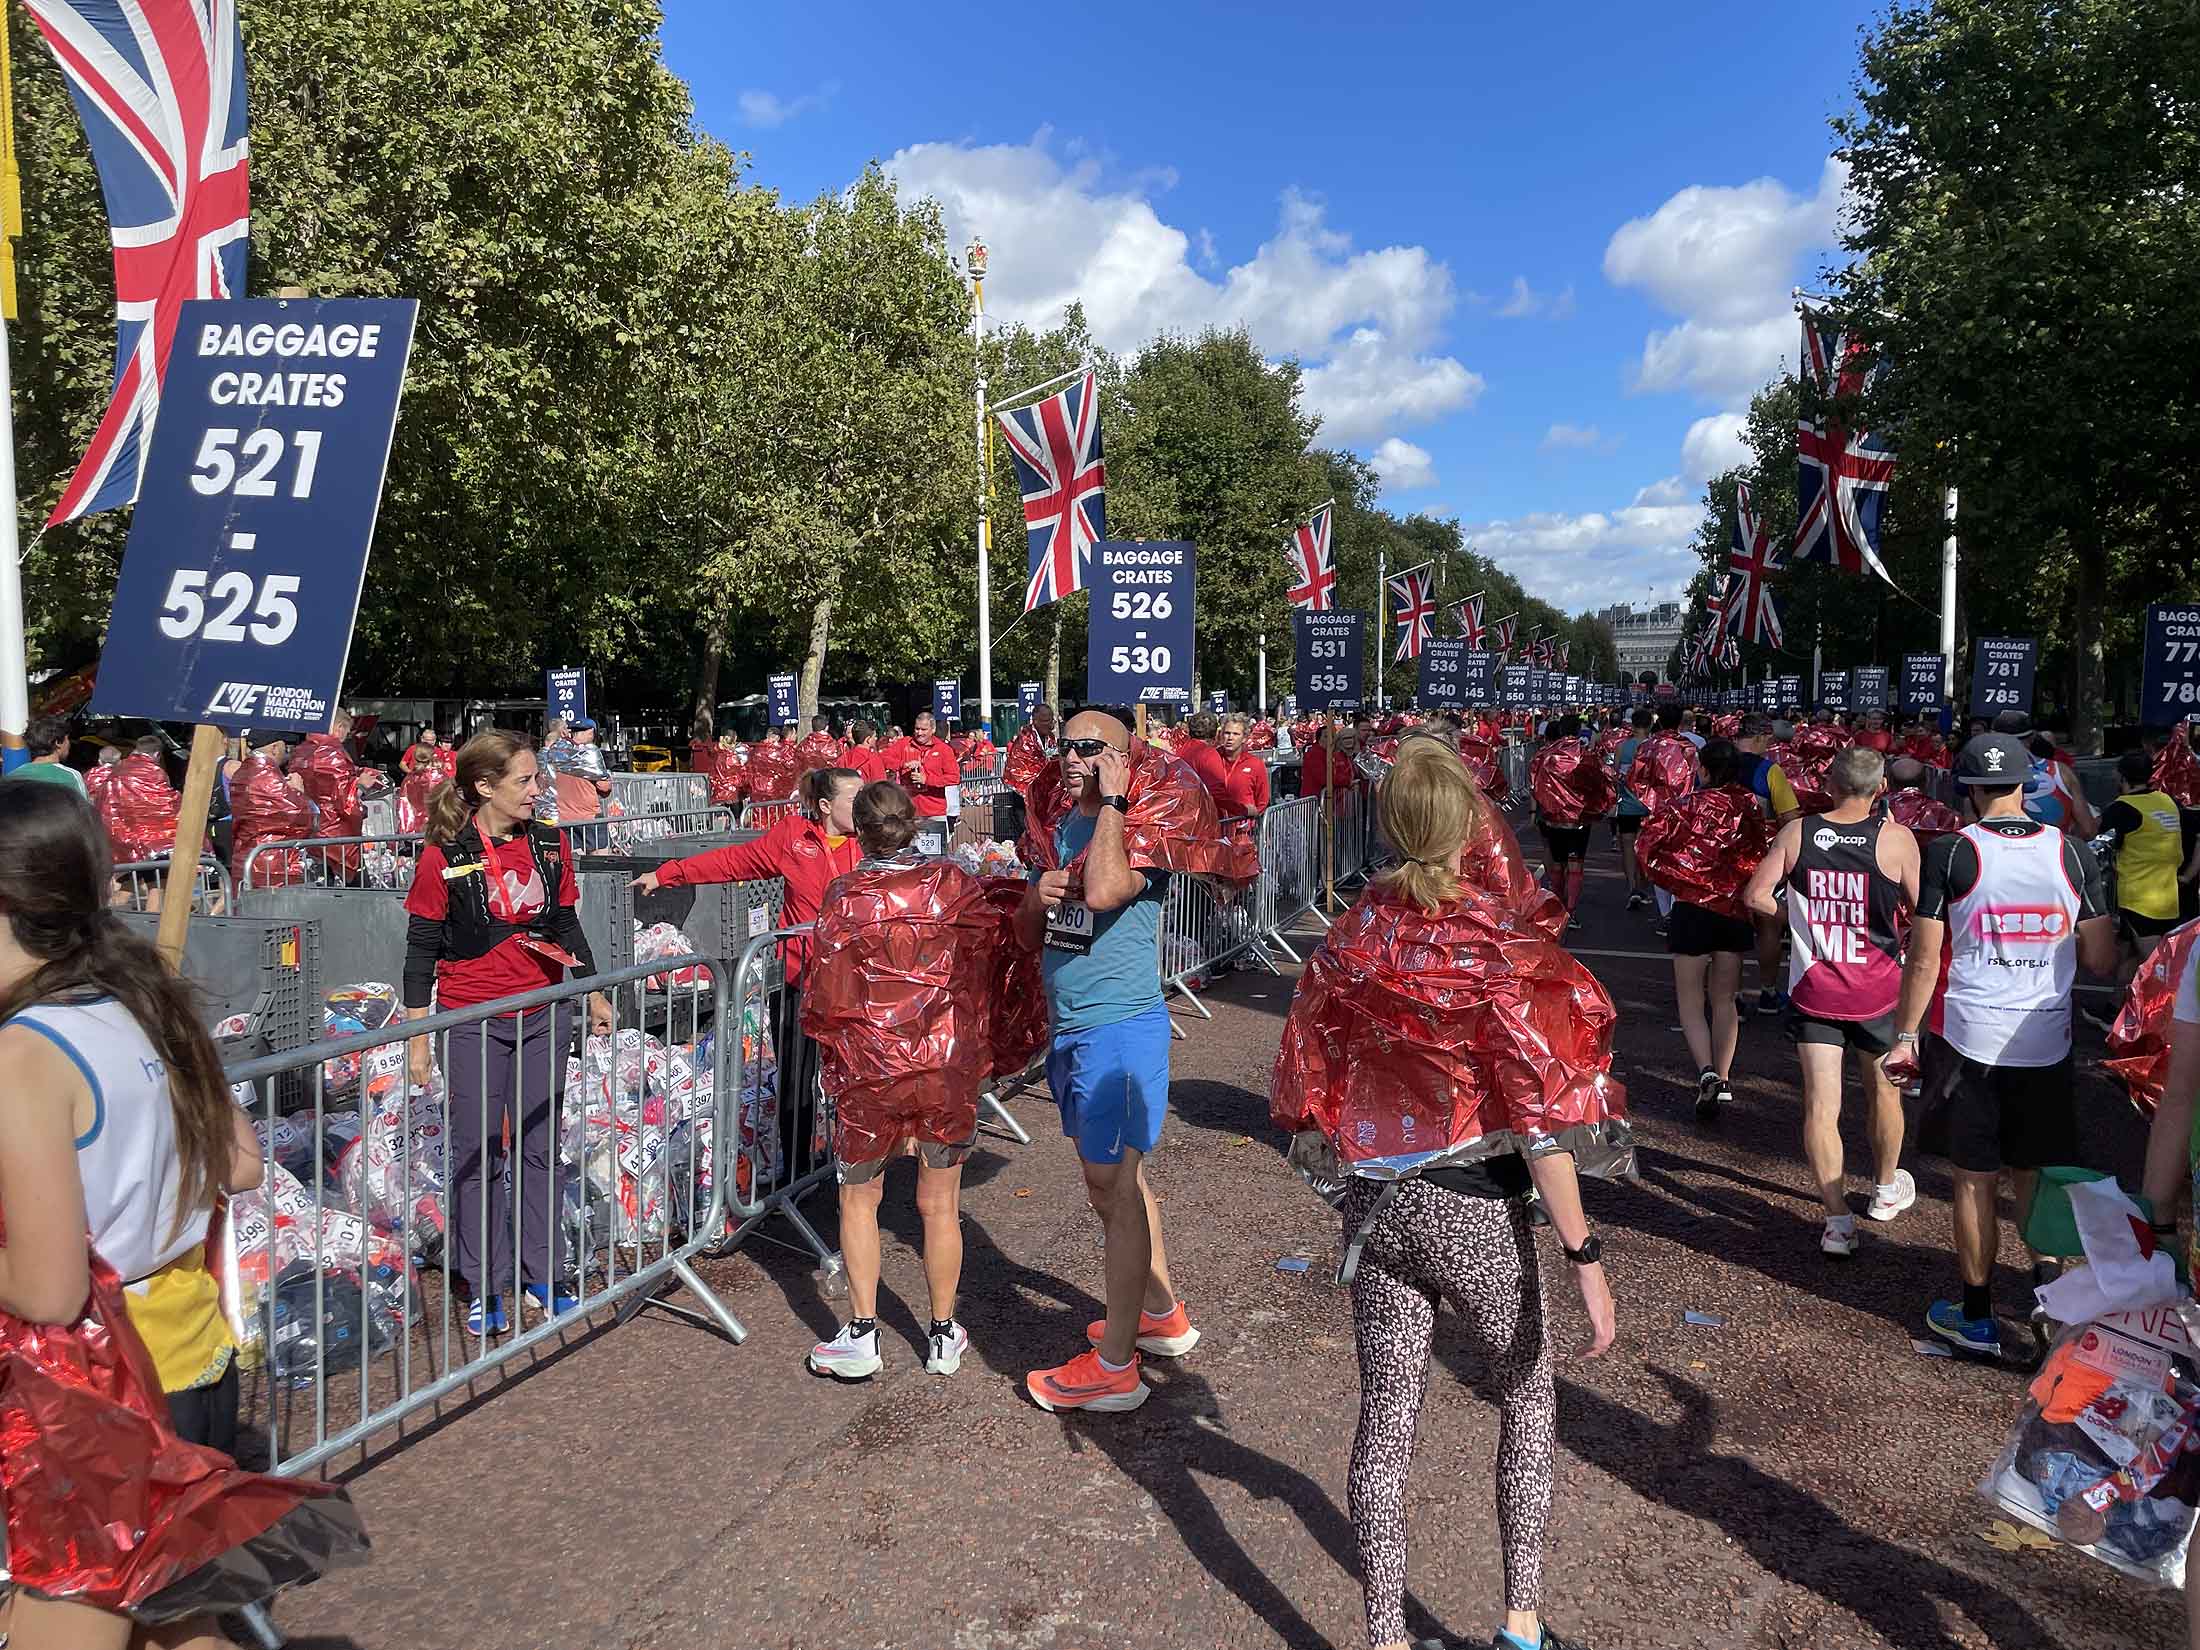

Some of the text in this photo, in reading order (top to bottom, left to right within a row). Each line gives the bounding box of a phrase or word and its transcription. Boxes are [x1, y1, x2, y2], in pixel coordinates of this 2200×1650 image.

[198, 323, 381, 358] BAGGAGE
[210, 371, 347, 408] CRATES
[191, 428, 323, 498] 521
[1103, 551, 1183, 565] BAGGAGE
[1112, 570, 1173, 584] CRATES
[159, 569, 301, 646] 525
[1111, 591, 1173, 620] 526
[1305, 615, 1356, 624] BAGGAGE
[2158, 611, 2200, 622] BAGG
[1312, 627, 1350, 636] CRATES
[1311, 640, 1346, 658] 531
[1427, 641, 1464, 649] BAGGAGE
[1984, 641, 2031, 650] BAGGAGE
[1989, 651, 2024, 660] CRATES
[2165, 642, 2200, 662] 77
[1110, 646, 1171, 674] 530
[1429, 660, 1458, 673] 536
[551, 671, 580, 679] BAGGAGE
[1988, 662, 2019, 677] 781
[1310, 674, 1348, 692] 535
[1507, 677, 1526, 686] 546
[1531, 680, 1542, 688] 51
[1911, 672, 1936, 683] 786
[1427, 683, 1456, 696] 540
[1860, 680, 1879, 689] 791
[268, 686, 313, 700] LONDON
[558, 688, 574, 701] 26
[776, 689, 788, 699] 31
[941, 691, 952, 700] 36
[1025, 692, 1034, 701] 41
[1506, 692, 1525, 701] 550
[1531, 693, 1542, 701] 55
[1909, 692, 1935, 703] 790
[1985, 689, 2020, 703] 785
[265, 697, 326, 712] MARATHON
[1859, 696, 1880, 704] 795
[263, 706, 303, 720] EVENTS
[560, 709, 575, 721] 30
[777, 706, 790, 716] 35
[941, 706, 953, 714] 40
[921, 839, 935, 847] 529
[1815, 832, 1867, 846] mencap
[1809, 870, 1865, 901] RUN
[1810, 899, 1865, 925] WITH
[1981, 912, 2064, 934] RSBC
[1811, 924, 1868, 964] ME
